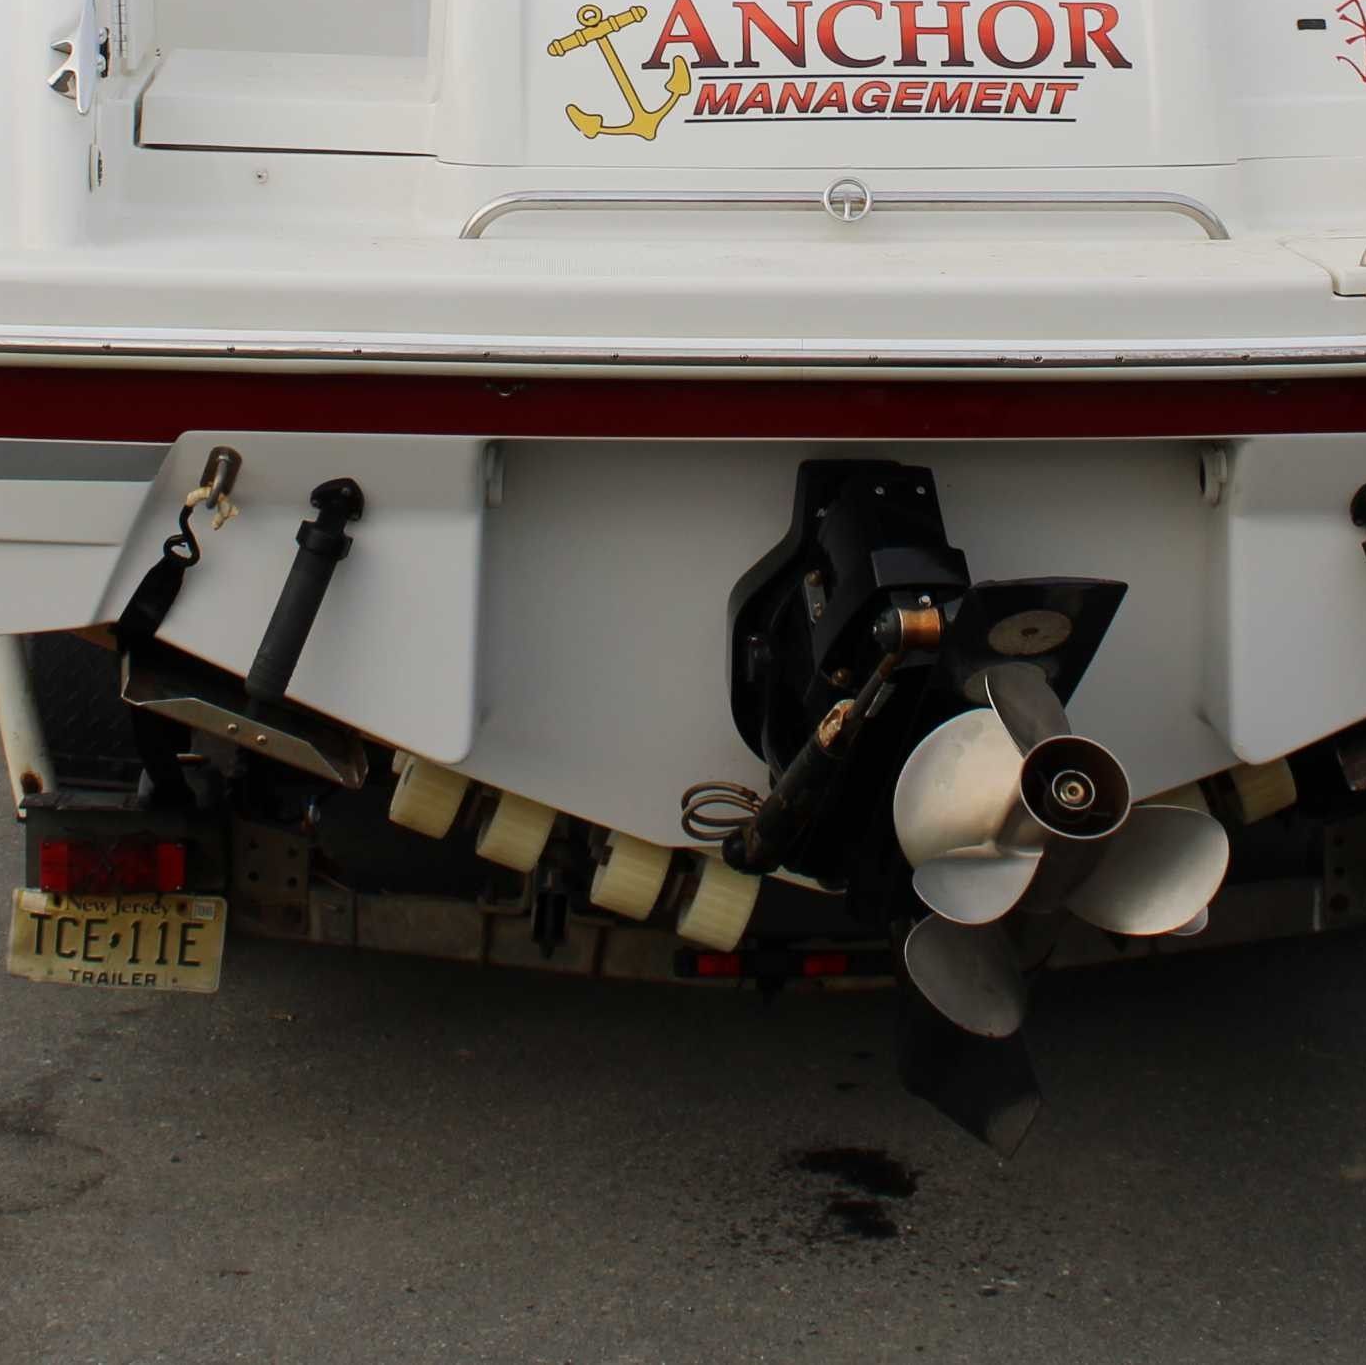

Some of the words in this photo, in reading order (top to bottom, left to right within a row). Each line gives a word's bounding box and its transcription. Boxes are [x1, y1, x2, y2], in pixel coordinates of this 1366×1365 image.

[693, 81, 1079, 116] MANAGEMENT
[66, 896, 109, 914] New
[112, 895, 172, 916] Jersey
[69, 969, 157, 986] TRAILER
